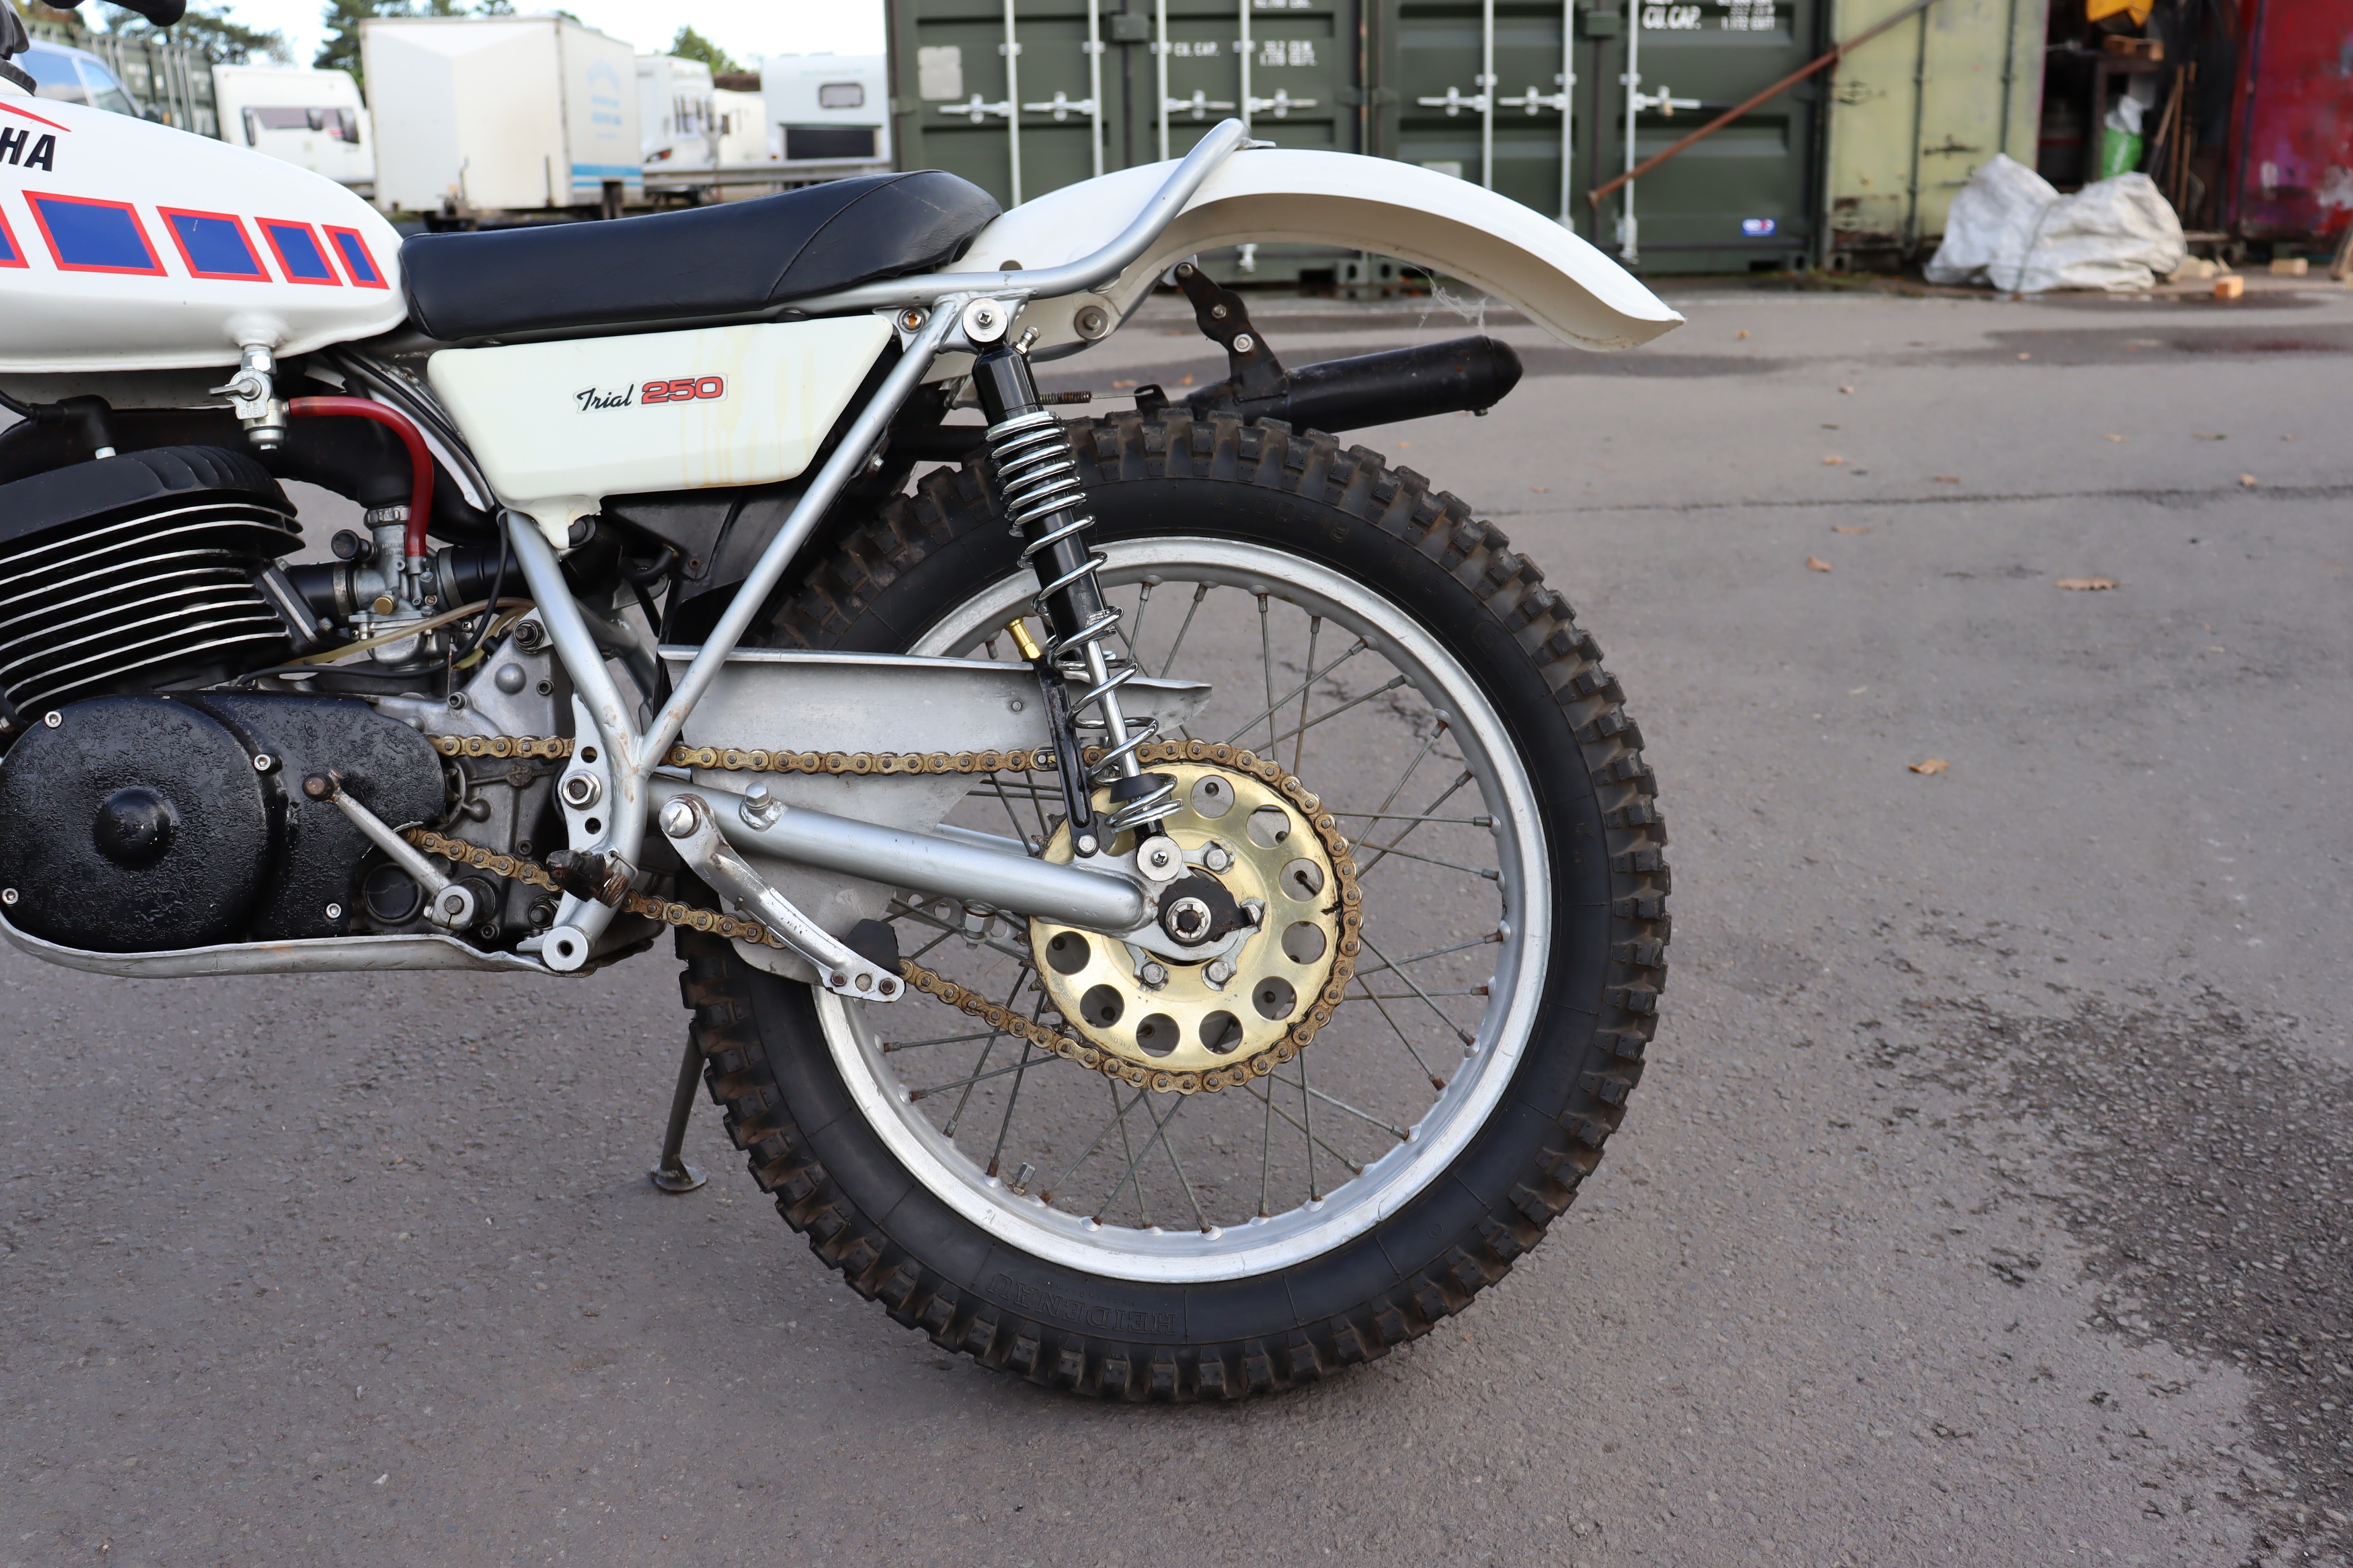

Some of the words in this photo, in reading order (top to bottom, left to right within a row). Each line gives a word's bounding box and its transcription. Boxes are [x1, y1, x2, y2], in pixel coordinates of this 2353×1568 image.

[577, 383, 634, 411] Trial
[641, 376, 723, 405] 250
[241, 407, 264, 417] FUEL
[1108, 1034, 1133, 1050] TALON
[987, 1273, 1176, 1335] HEIDENAU
